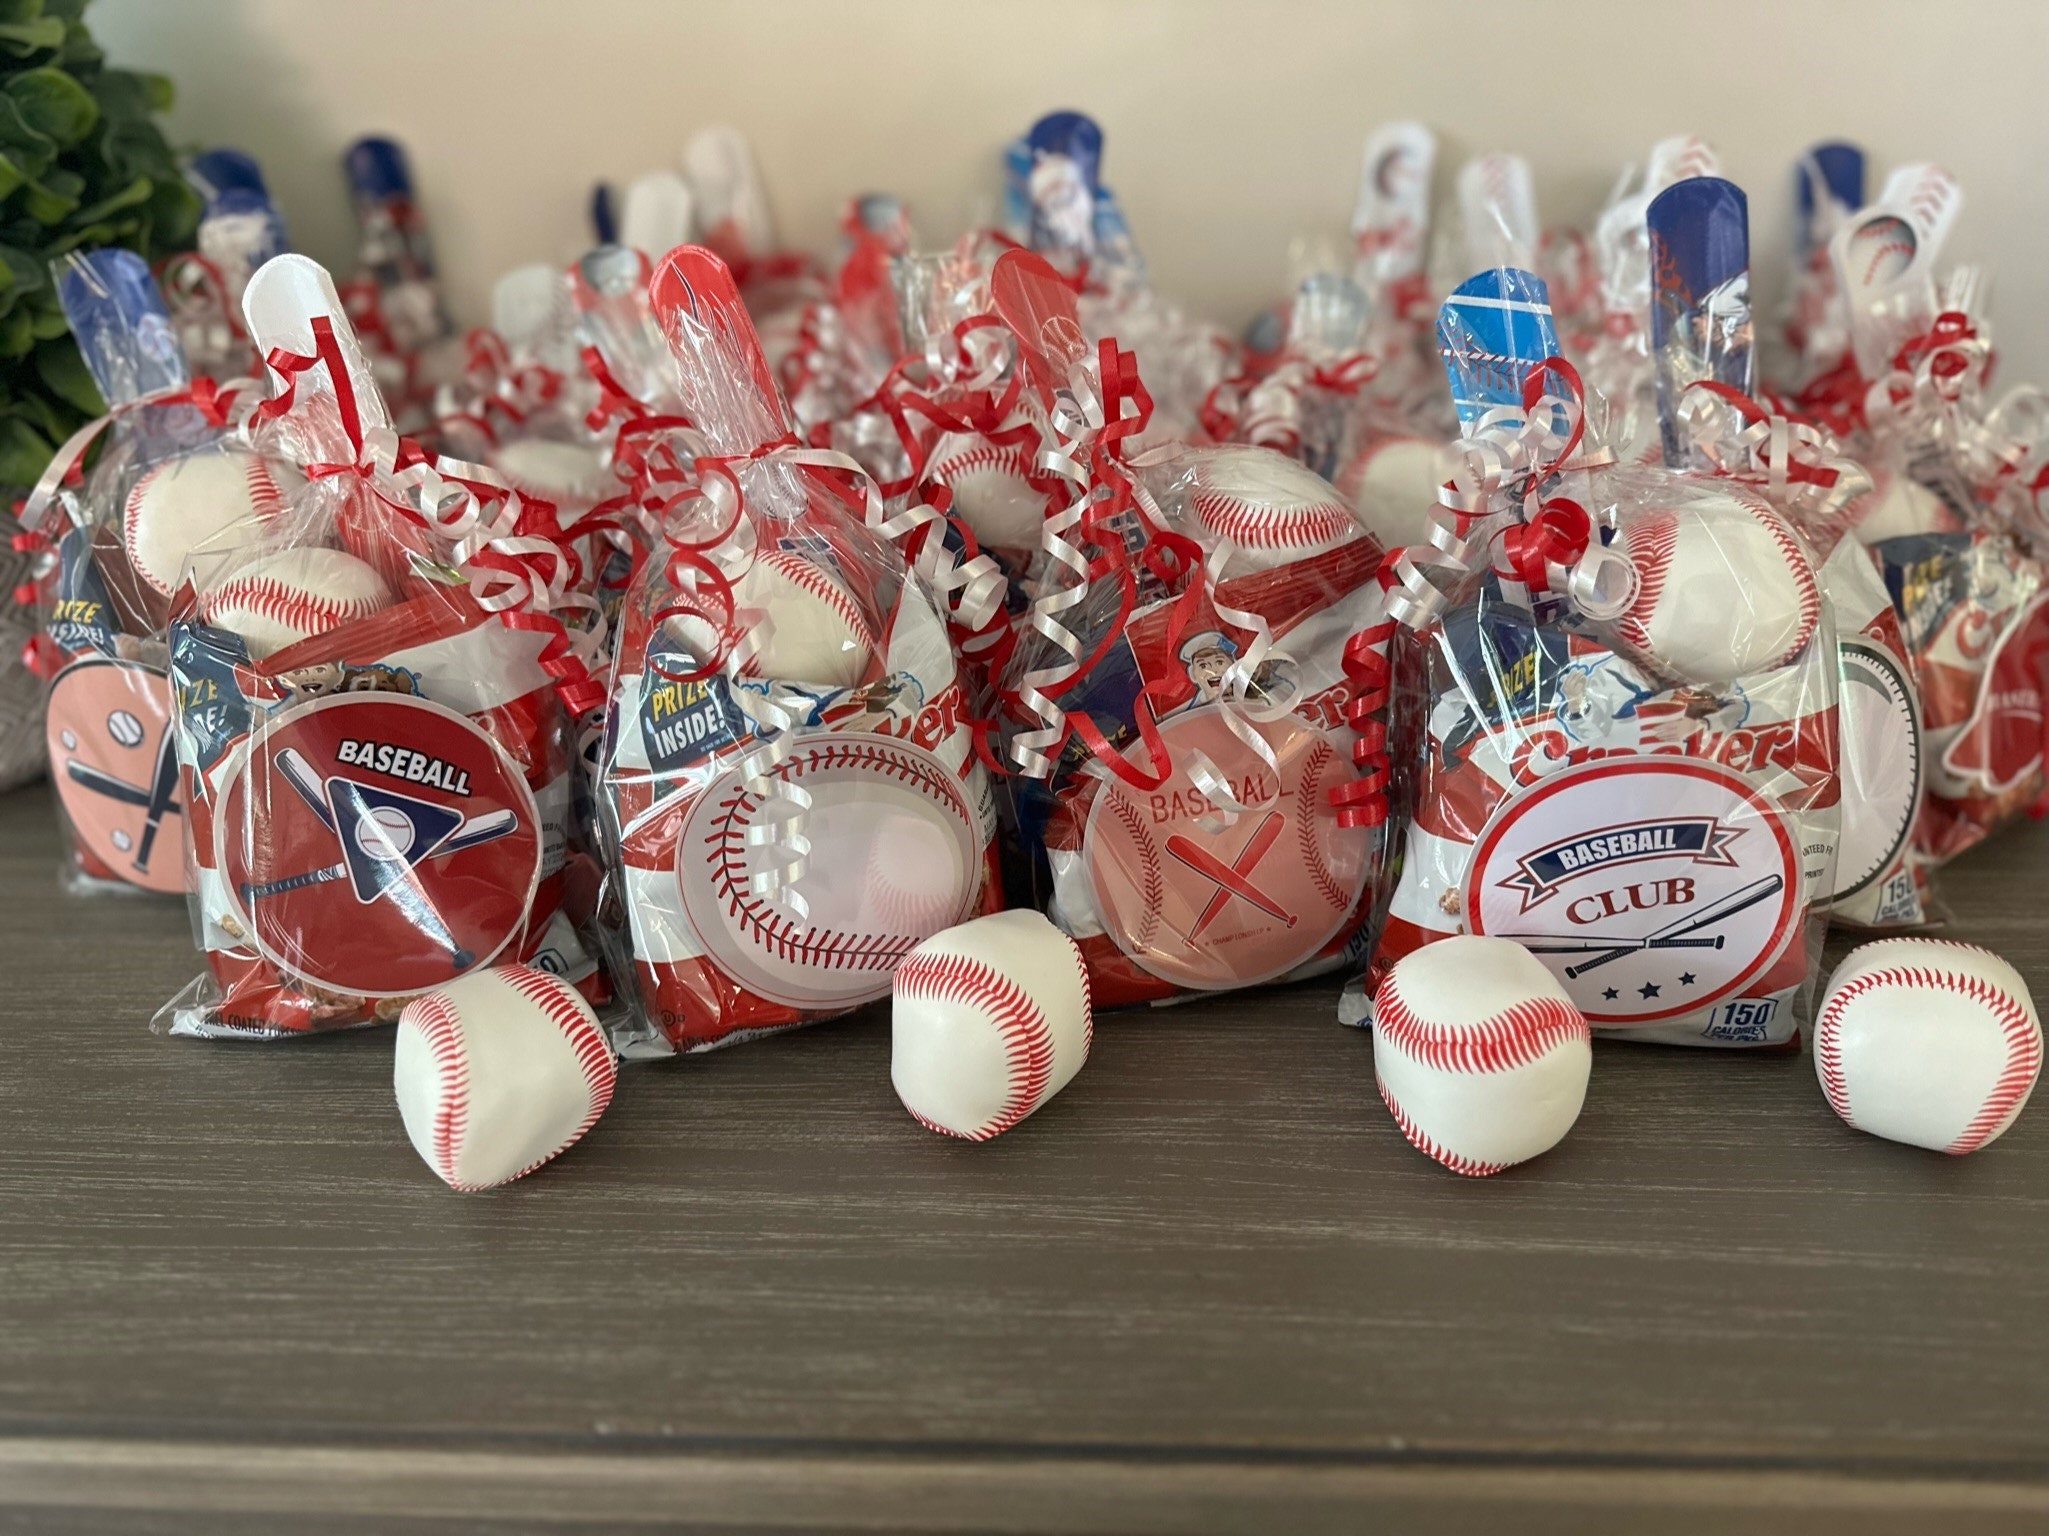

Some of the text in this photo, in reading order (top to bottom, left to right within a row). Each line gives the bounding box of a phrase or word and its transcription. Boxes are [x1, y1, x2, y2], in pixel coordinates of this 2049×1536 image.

[651, 680, 709, 722] PRIZE
[654, 698, 726, 759] INSIDE!
[338, 740, 470, 796] BASEBALL
[1557, 828, 1676, 870] BASEBALL
[1566, 878, 1695, 925] CLUB
[1724, 1002, 1770, 1025] 150
